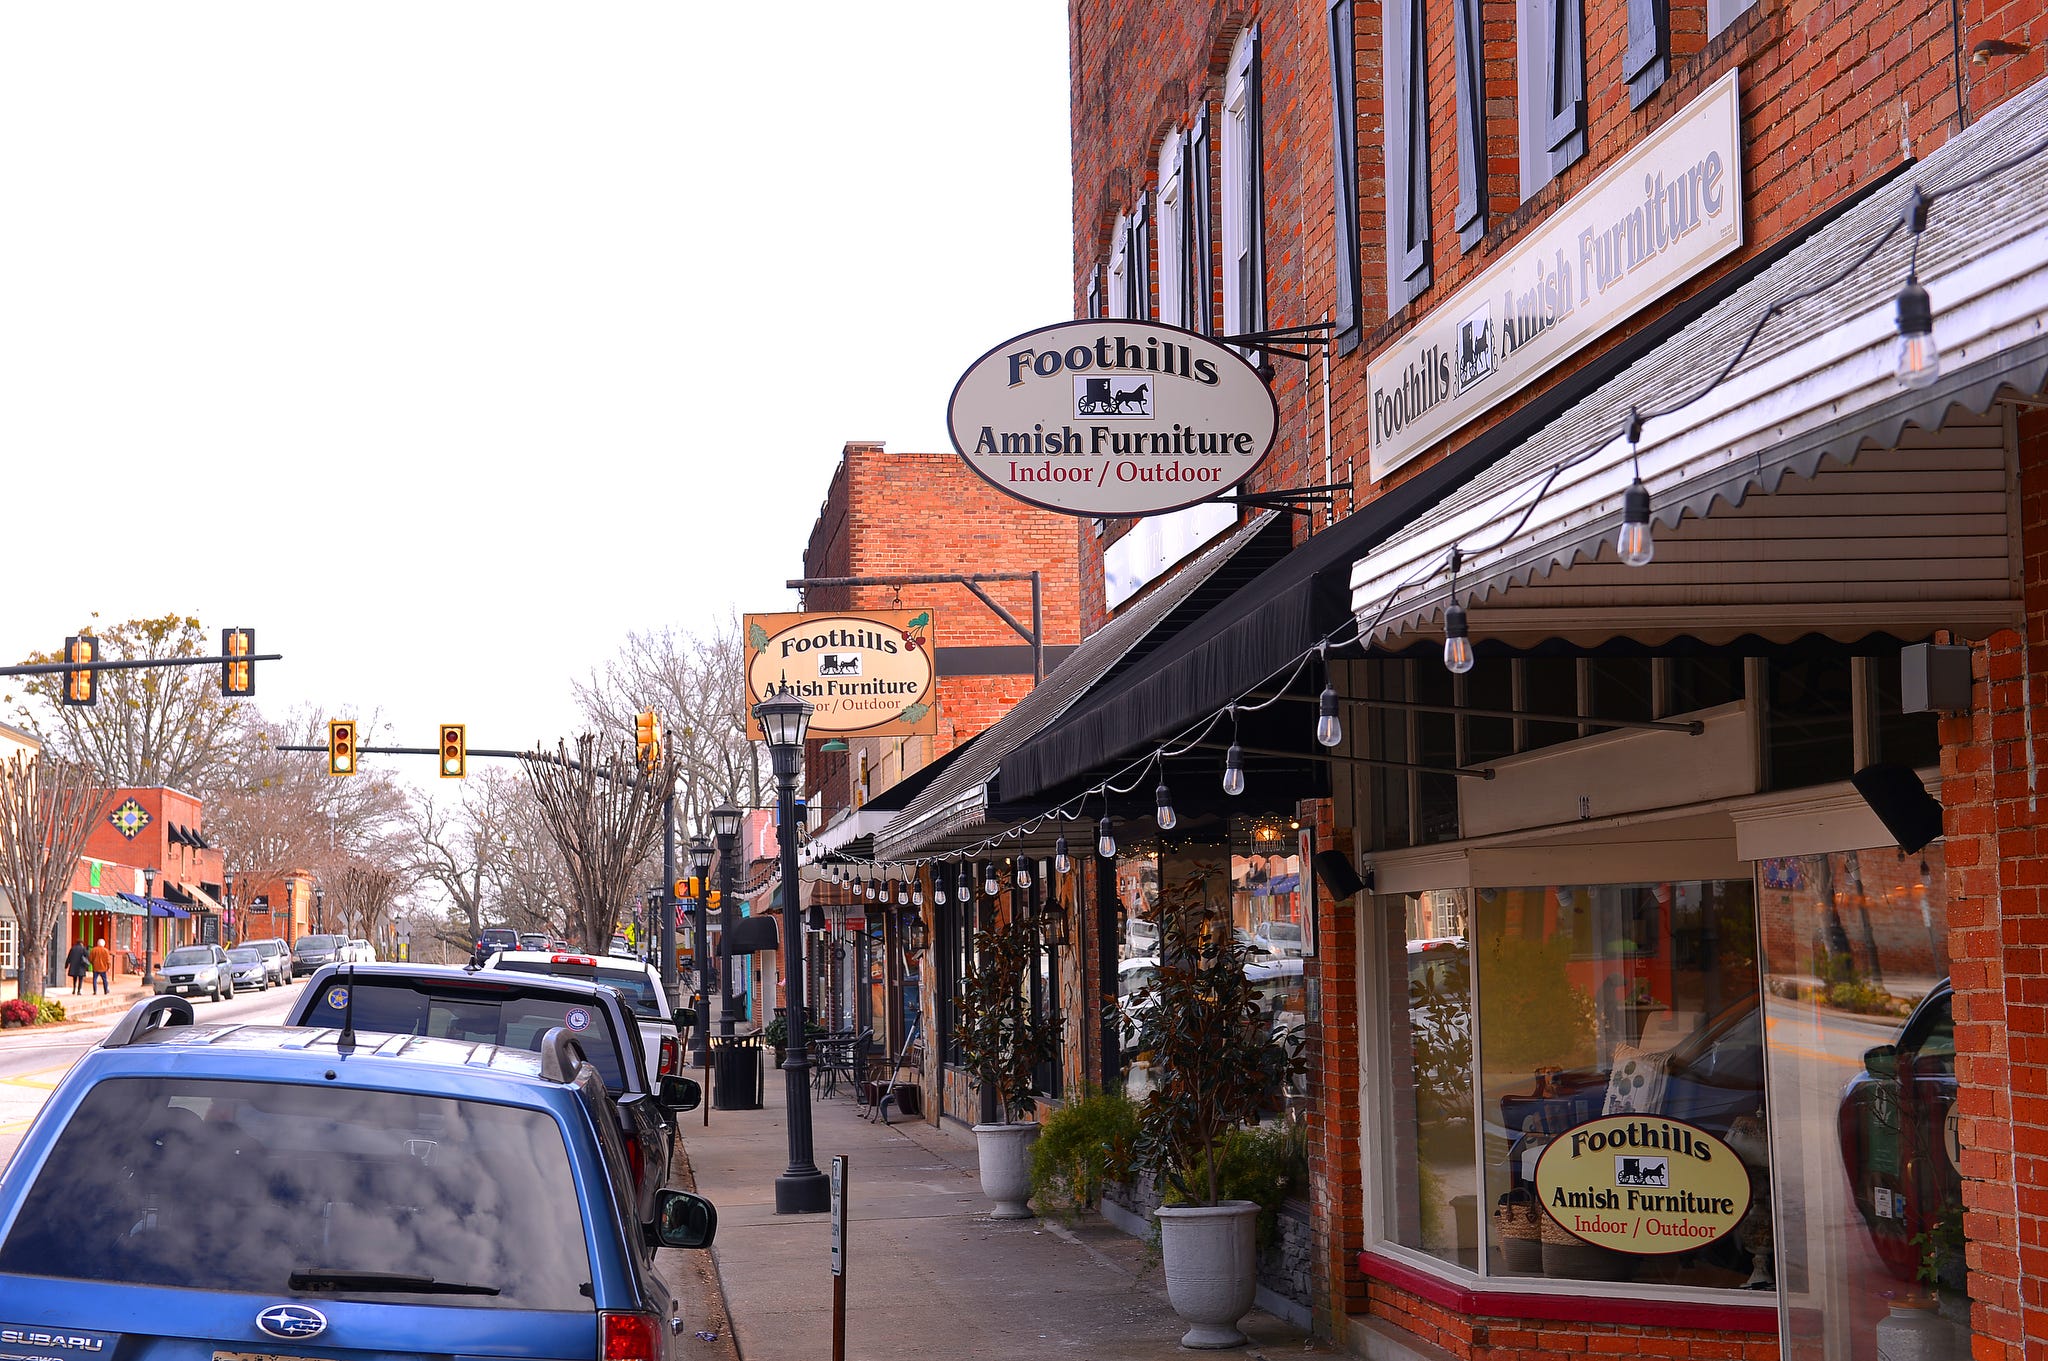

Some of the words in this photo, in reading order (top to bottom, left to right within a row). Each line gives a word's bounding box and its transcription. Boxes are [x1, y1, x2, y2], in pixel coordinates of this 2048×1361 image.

[1374, 345, 1450, 449] Foothills
[1501, 248, 1574, 360] Amish
[1578, 150, 1724, 305] Furniture
[1007, 335, 1220, 387] Foothills
[974, 423, 1083, 455] Amish
[1090, 423, 1254, 455] Furniture
[1008, 461, 1094, 482] Indoor
[1116, 461, 1222, 482] Outdoor
[781, 629, 898, 658] Foothills
[827, 678, 918, 696] Furniture
[842, 698, 901, 711] Outdoor
[1571, 1122, 1713, 1161] Foothills
[1552, 1186, 1619, 1209] Amish
[1627, 1190, 1734, 1215] Furniture
[1574, 1215, 1628, 1234] Indoor
[1646, 1218, 1716, 1239] Outdoor
[1, 1330, 103, 1352] SUBARU
